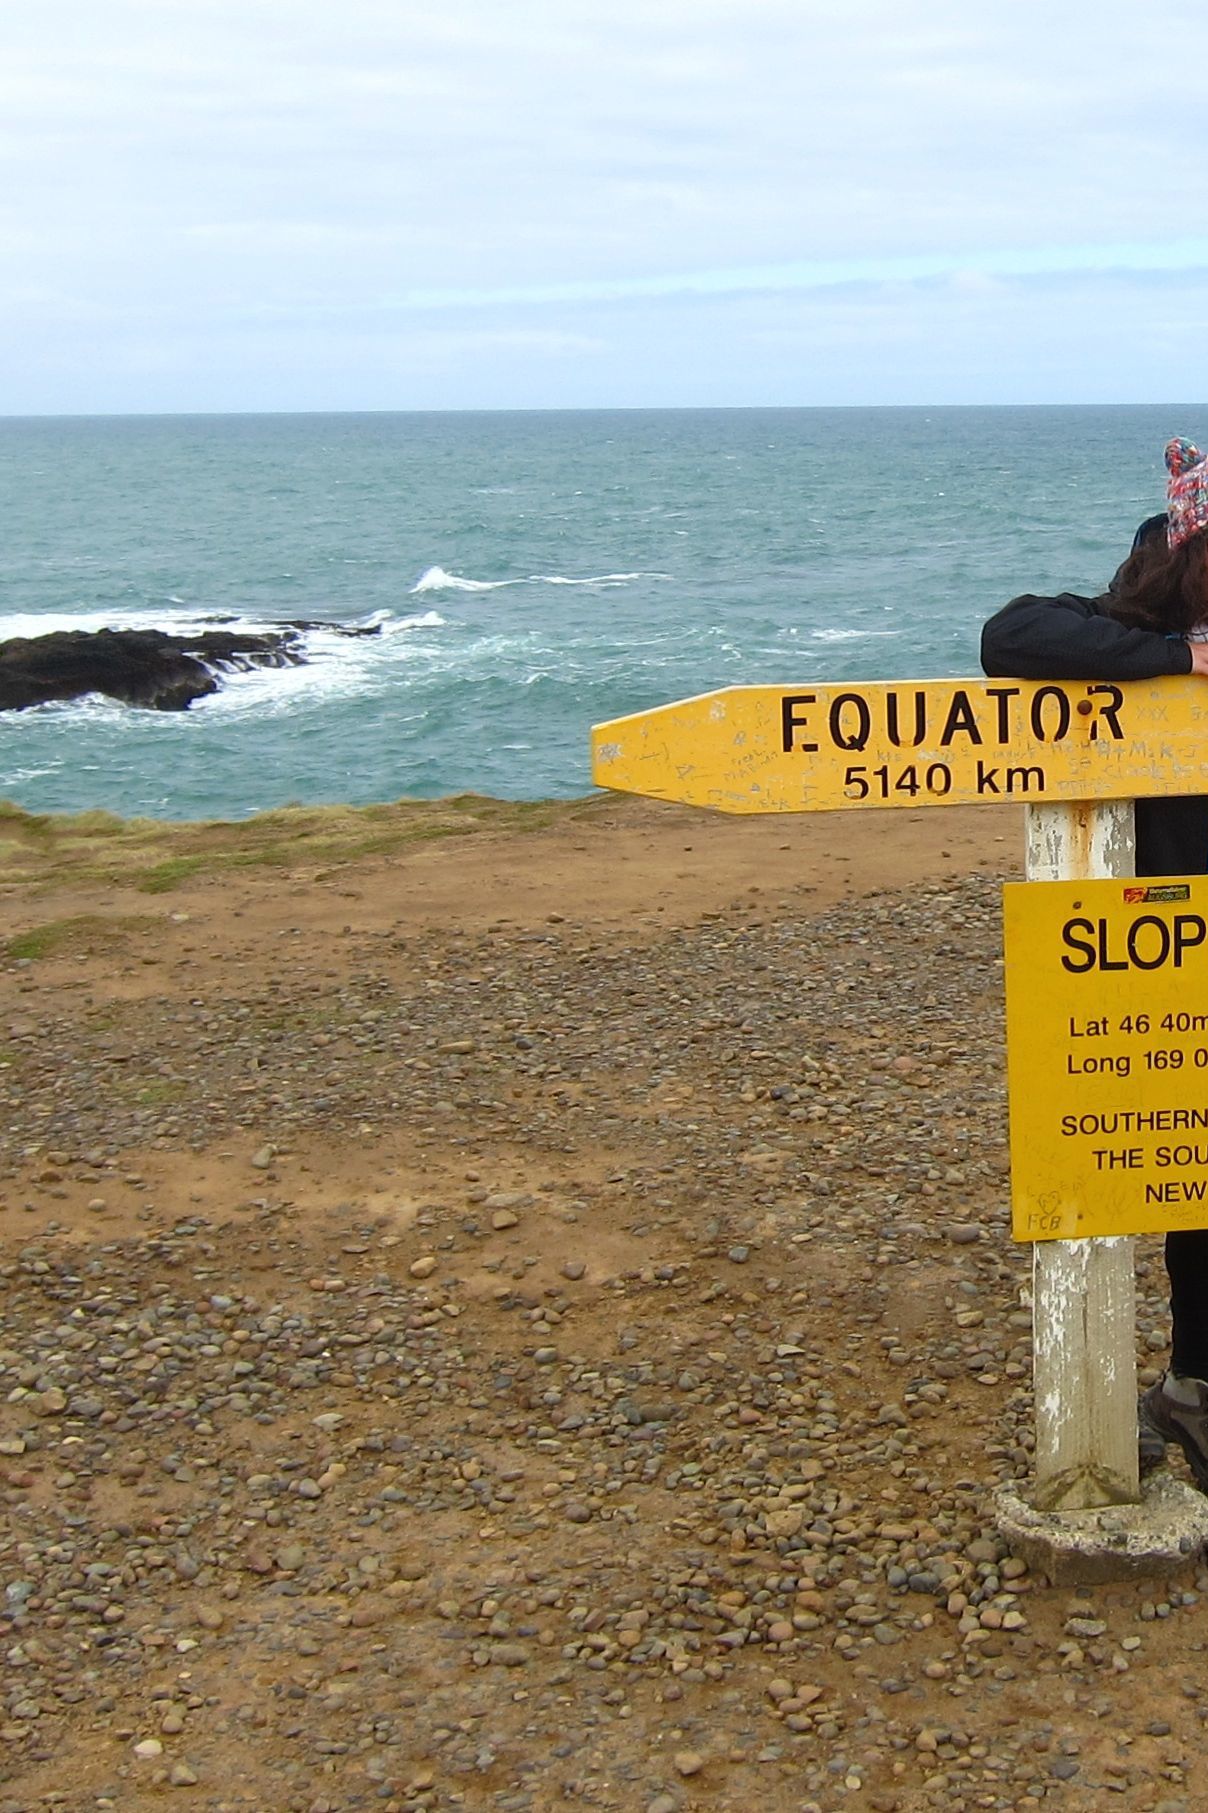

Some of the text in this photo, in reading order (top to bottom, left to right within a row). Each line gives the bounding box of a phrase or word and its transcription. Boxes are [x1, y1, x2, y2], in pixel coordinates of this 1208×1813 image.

[781, 684, 1125, 752] EQUATOR
[845, 762, 952, 799] 5140
[977, 760, 1045, 794] km
[1070, 1016, 1109, 1037] Lat
[1119, 1014, 1150, 1034] 46
[1068, 1054, 1131, 1078] Long
[1143, 1049, 1184, 1070] 169
[1061, 1108, 1208, 1136] SOUTHERN
[1092, 1148, 1144, 1170] THE
[1145, 1180, 1207, 1204] NEW
